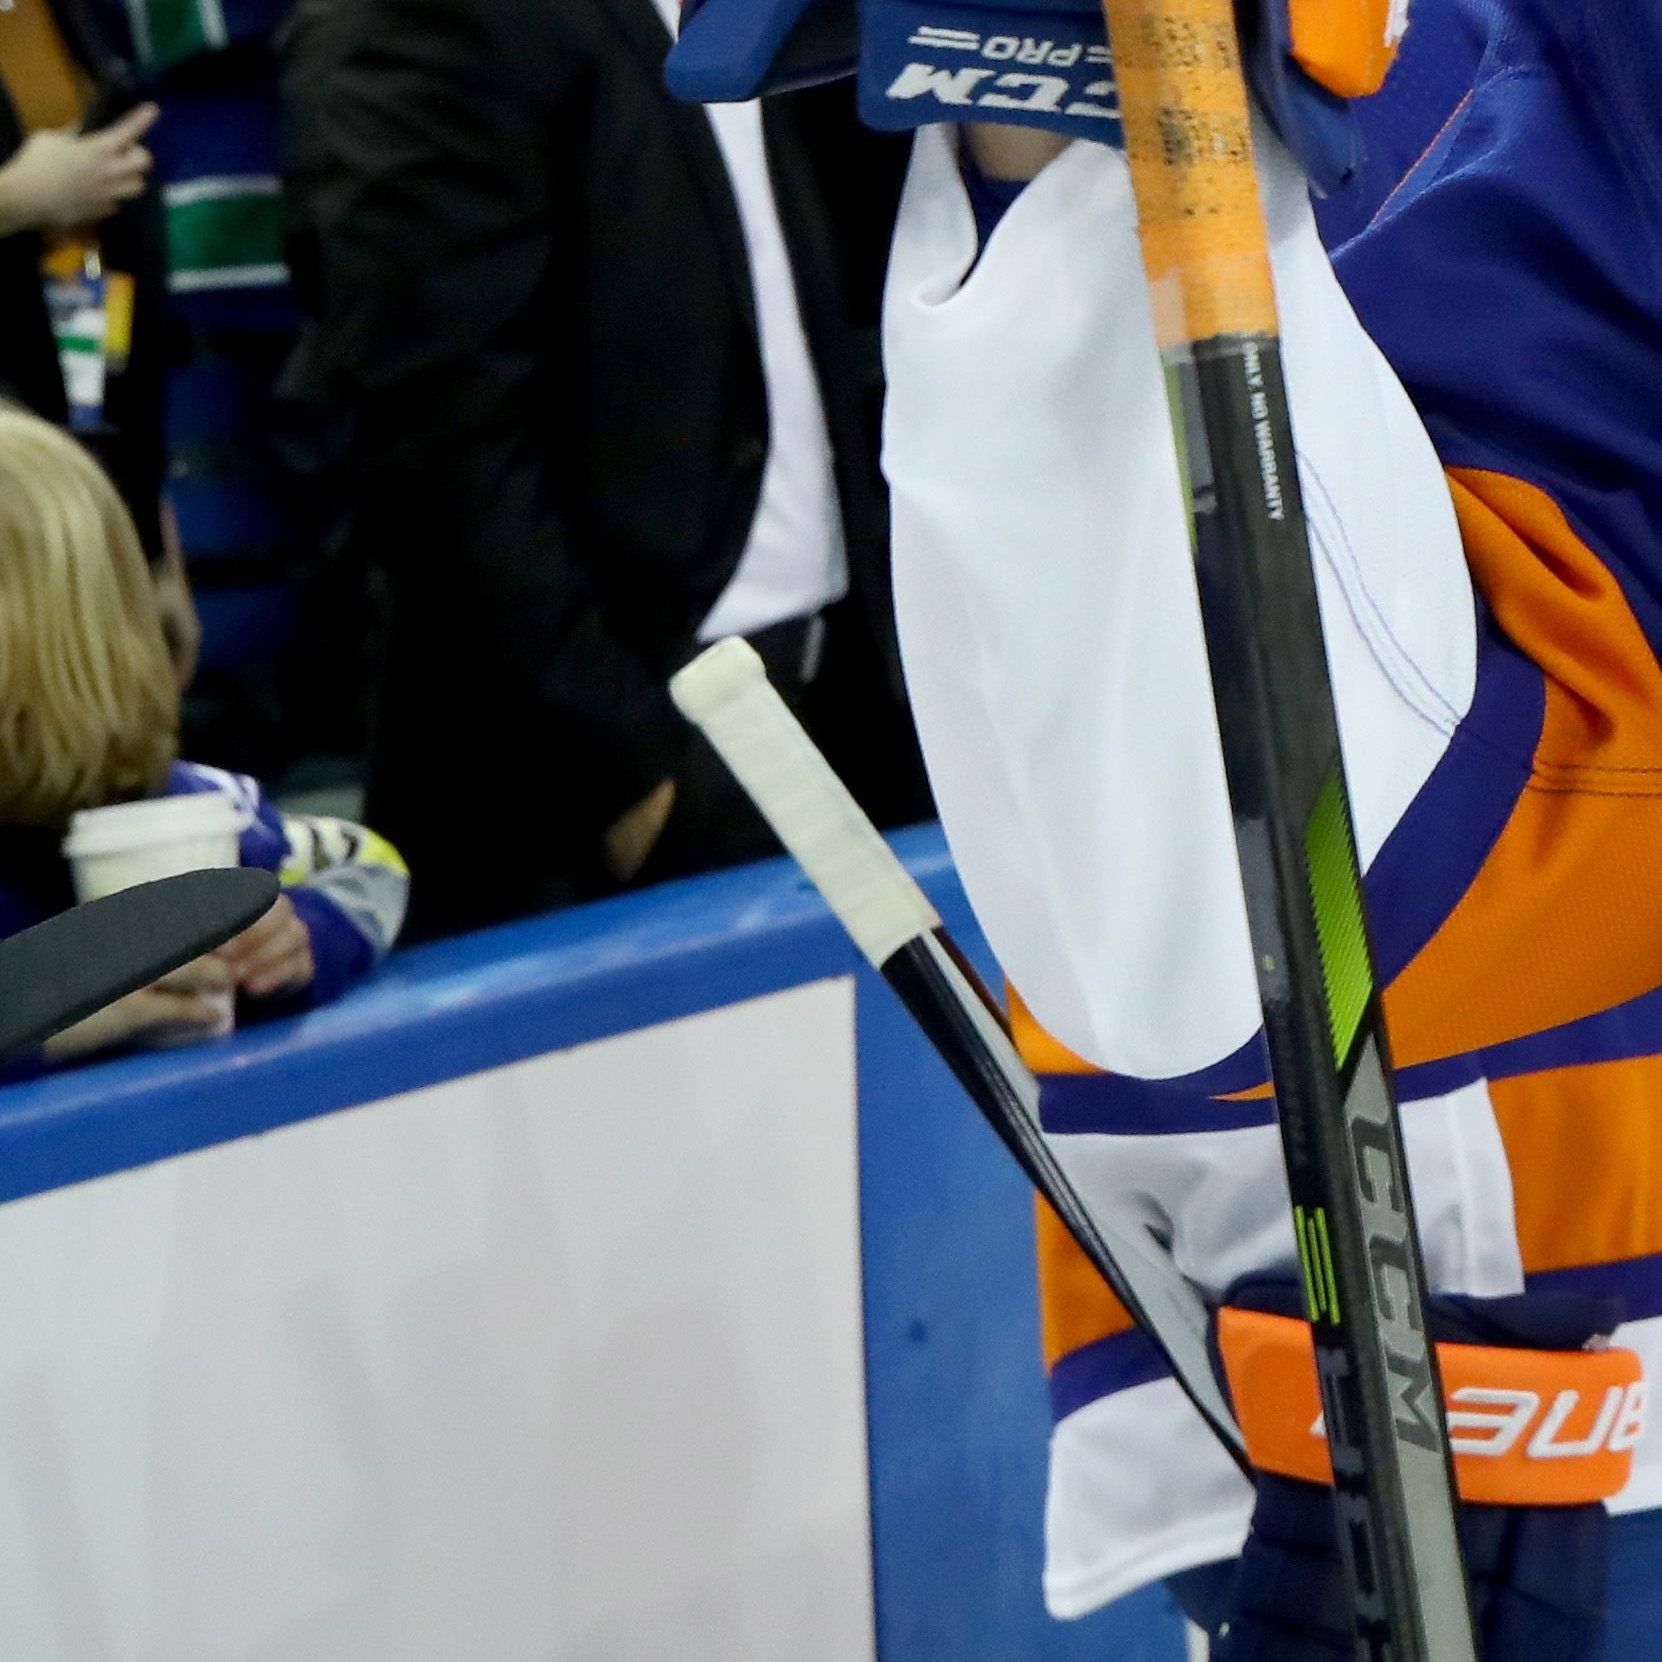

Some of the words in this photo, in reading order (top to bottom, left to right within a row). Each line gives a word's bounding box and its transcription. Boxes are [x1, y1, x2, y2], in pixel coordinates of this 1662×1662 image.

[981, 36, 1083, 68] PRO
[1250, 392, 1269, 420] NO
[1254, 420, 1285, 520] WARRANTY
[1351, 1116, 1442, 1452] CCM
